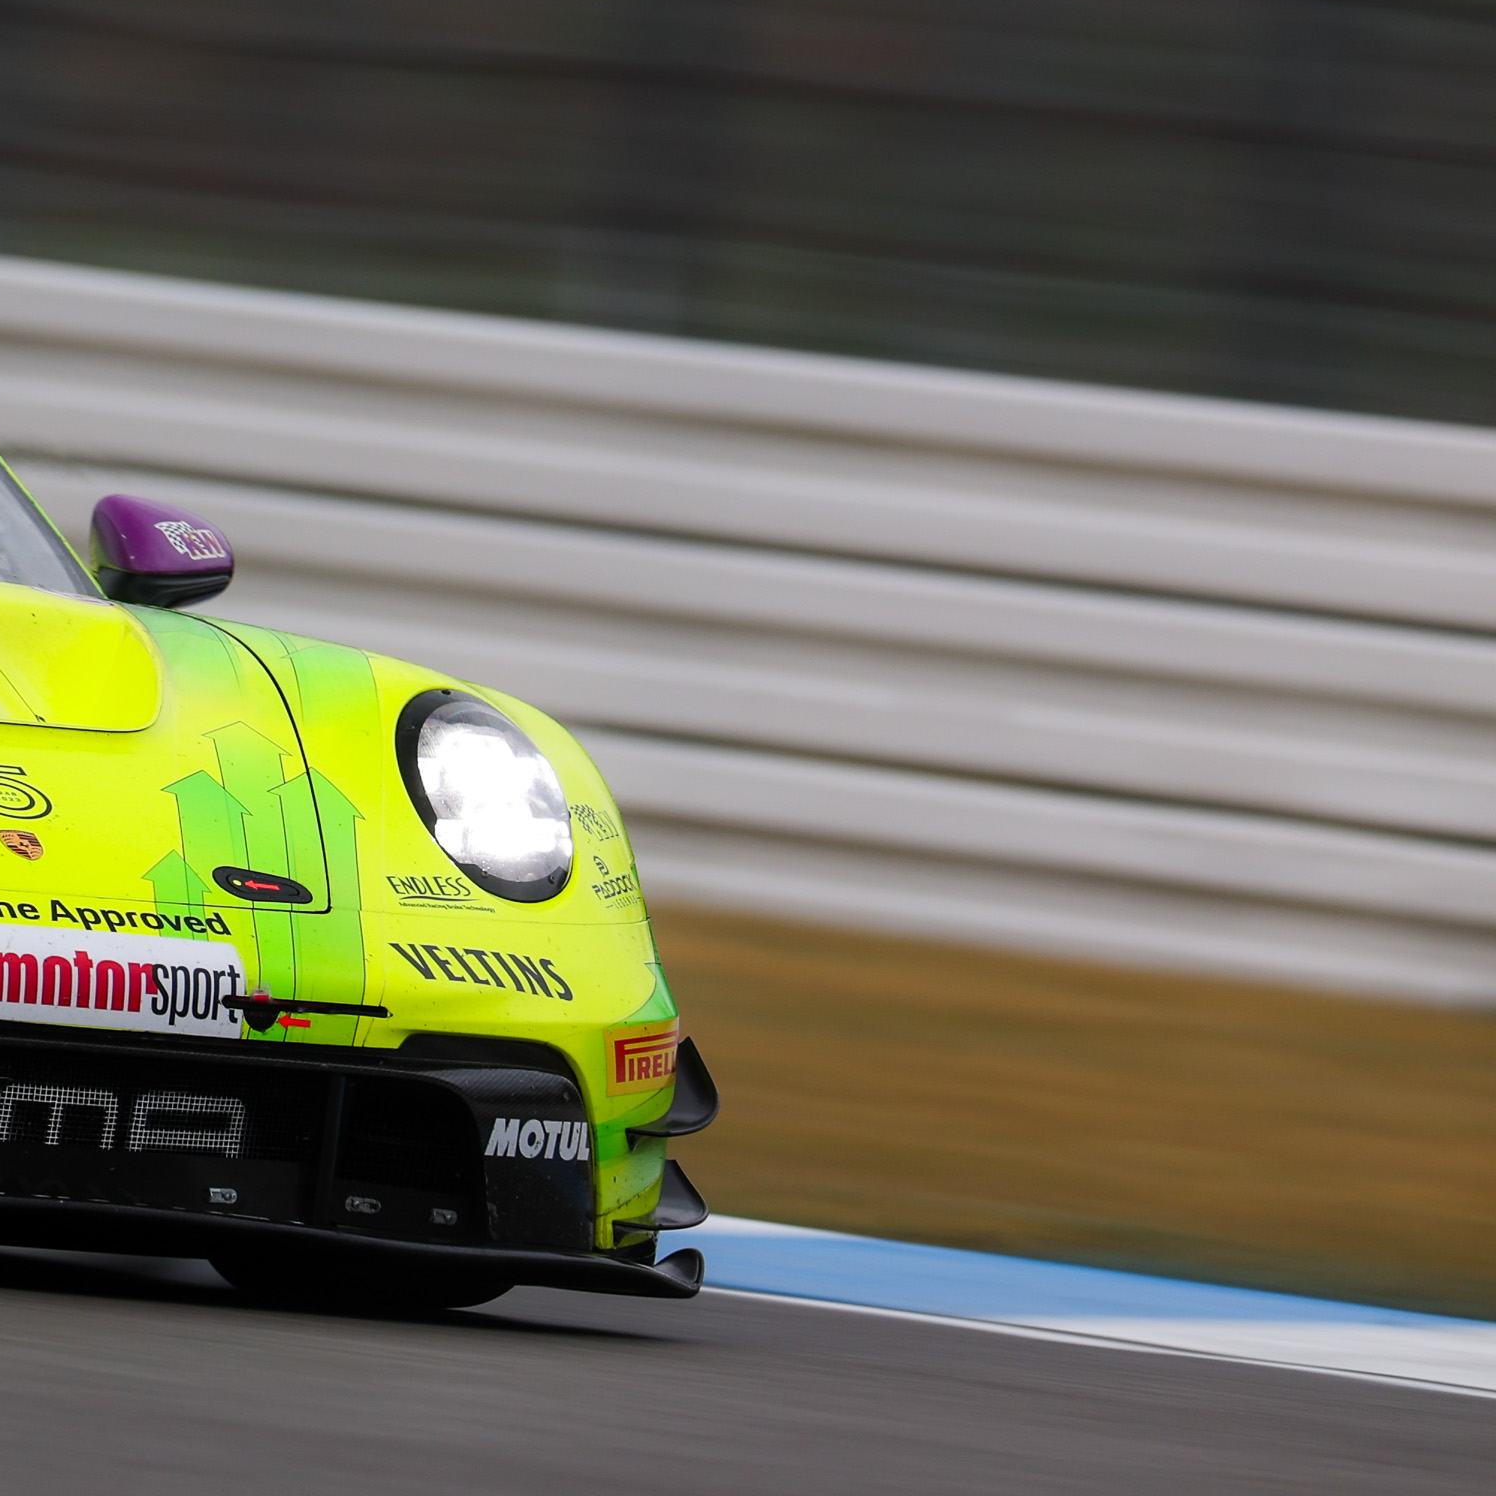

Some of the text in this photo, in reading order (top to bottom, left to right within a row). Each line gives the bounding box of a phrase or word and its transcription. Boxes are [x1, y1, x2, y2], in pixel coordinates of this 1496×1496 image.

[386, 875, 472, 898] ENDLESS
[50, 899, 233, 936] Approved
[388, 942, 574, 1002] VELTINS
[484, 1117, 591, 1162] MOTUL
